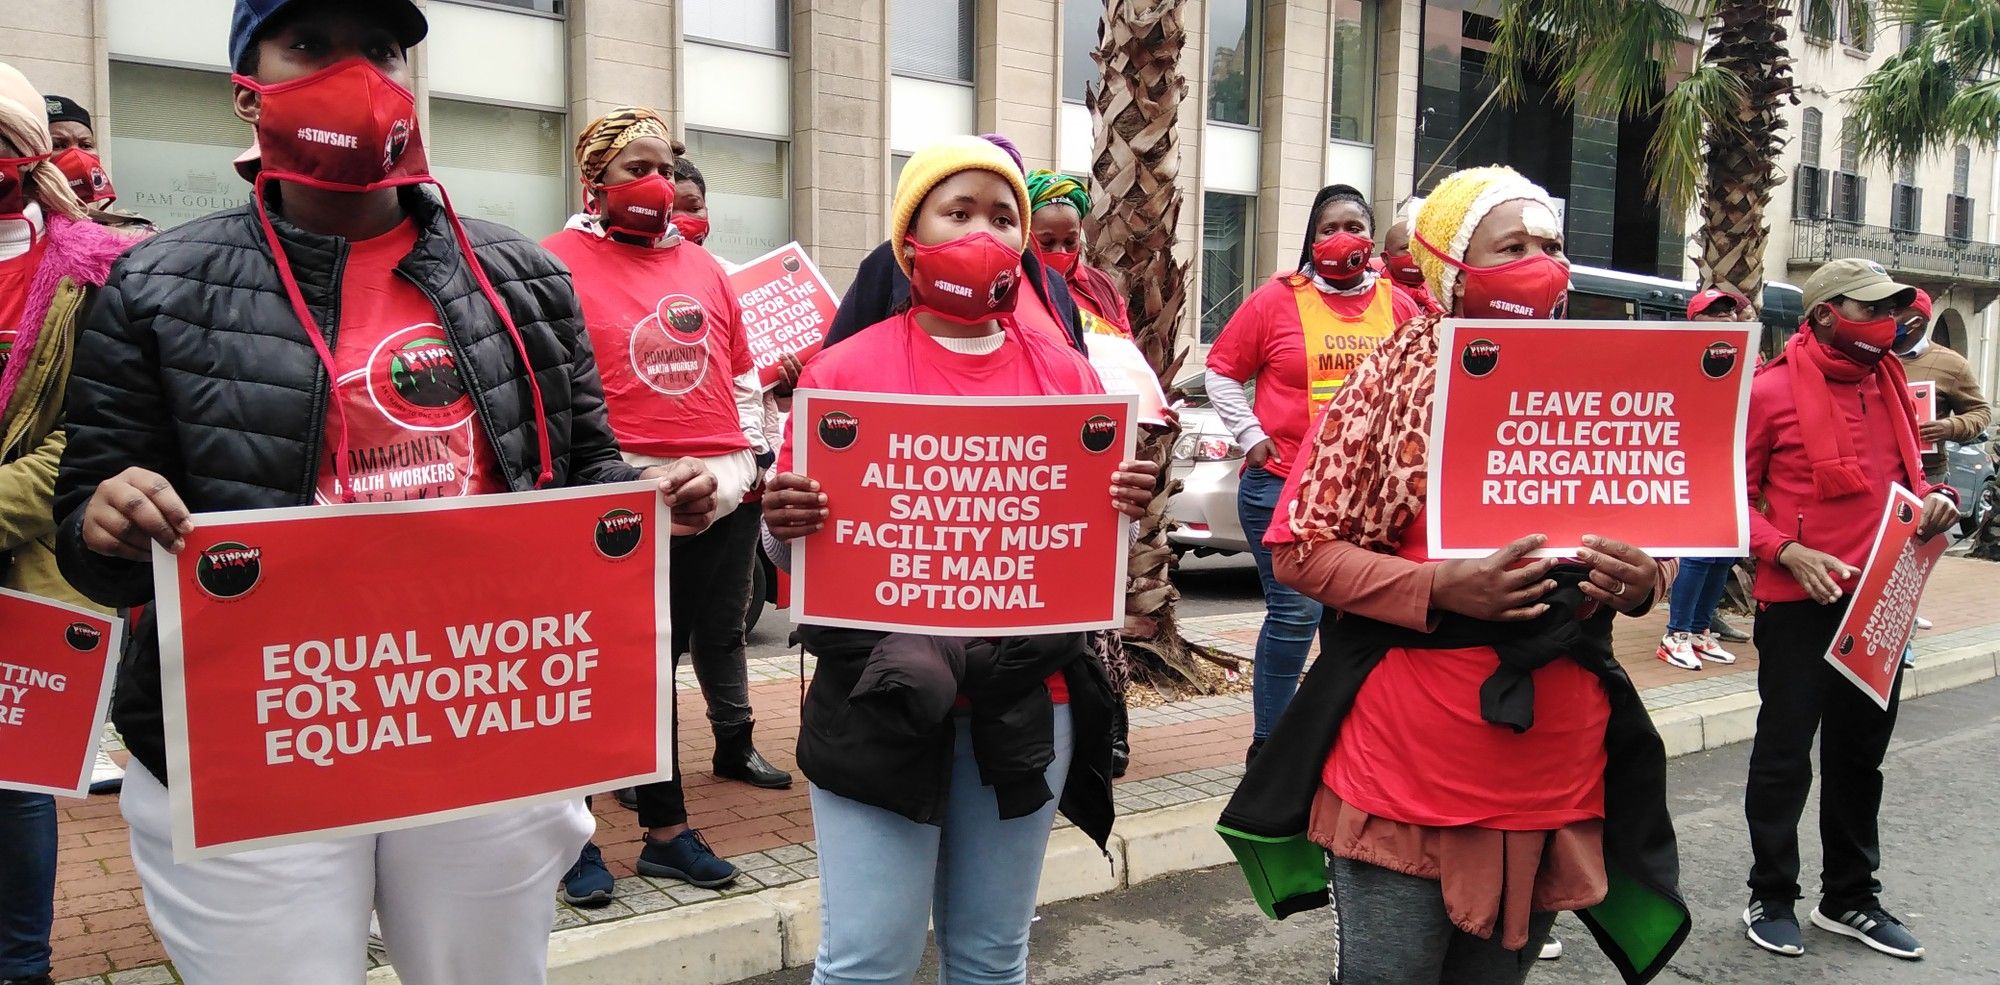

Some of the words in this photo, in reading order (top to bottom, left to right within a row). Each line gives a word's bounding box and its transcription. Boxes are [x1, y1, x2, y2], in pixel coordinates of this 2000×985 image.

[298, 127, 358, 149] #STAYSAFE
[136, 191, 173, 205] PAM
[738, 273, 796, 308] GENTLY
[756, 296, 788, 317] FOR
[786, 281, 818, 301] THE
[935, 280, 973, 298] #STAYSAFE
[746, 298, 816, 340] LIZATION
[1489, 300, 1534, 316] #STAYSAFE
[774, 311, 824, 342] GRADE
[644, 347, 697, 364] COMMUNITY
[647, 364, 669, 375] HEALTH
[670, 361, 698, 372] WORKERS
[1319, 353, 1369, 370] MARS
[1508, 391, 1603, 417] LEAVE
[1610, 391, 1675, 417] OUR
[1496, 420, 1681, 446] COLLECTIVE
[888, 433, 1048, 463] HOUSING
[1486, 449, 1687, 475] BARGAINING
[389, 463, 455, 488] WORKERS
[860, 462, 1068, 492] ALLOWANCE
[1481, 479, 1581, 505] RIGHT
[1588, 479, 1691, 506] ALONE
[889, 493, 1040, 522] SAVINGS
[836, 519, 991, 552] FACILITY
[1000, 522, 1089, 551] MUST
[889, 554, 932, 580] BE
[941, 555, 1035, 581] MADE
[875, 581, 1045, 611] OPTIONAL
[1861, 536, 1911, 642] IMPLEMENT
[1884, 602, 1914, 675] SCHEME
[1912, 556, 1929, 601] NOW
[262, 630, 432, 683] EQUAL
[445, 610, 593, 659] WORK
[0, 662, 67, 692] TING
[256, 677, 359, 725] FOR
[374, 658, 529, 708] WORK
[541, 648, 599, 687] OF
[265, 711, 432, 767] EQUAL
[444, 687, 592, 739] VALUE
